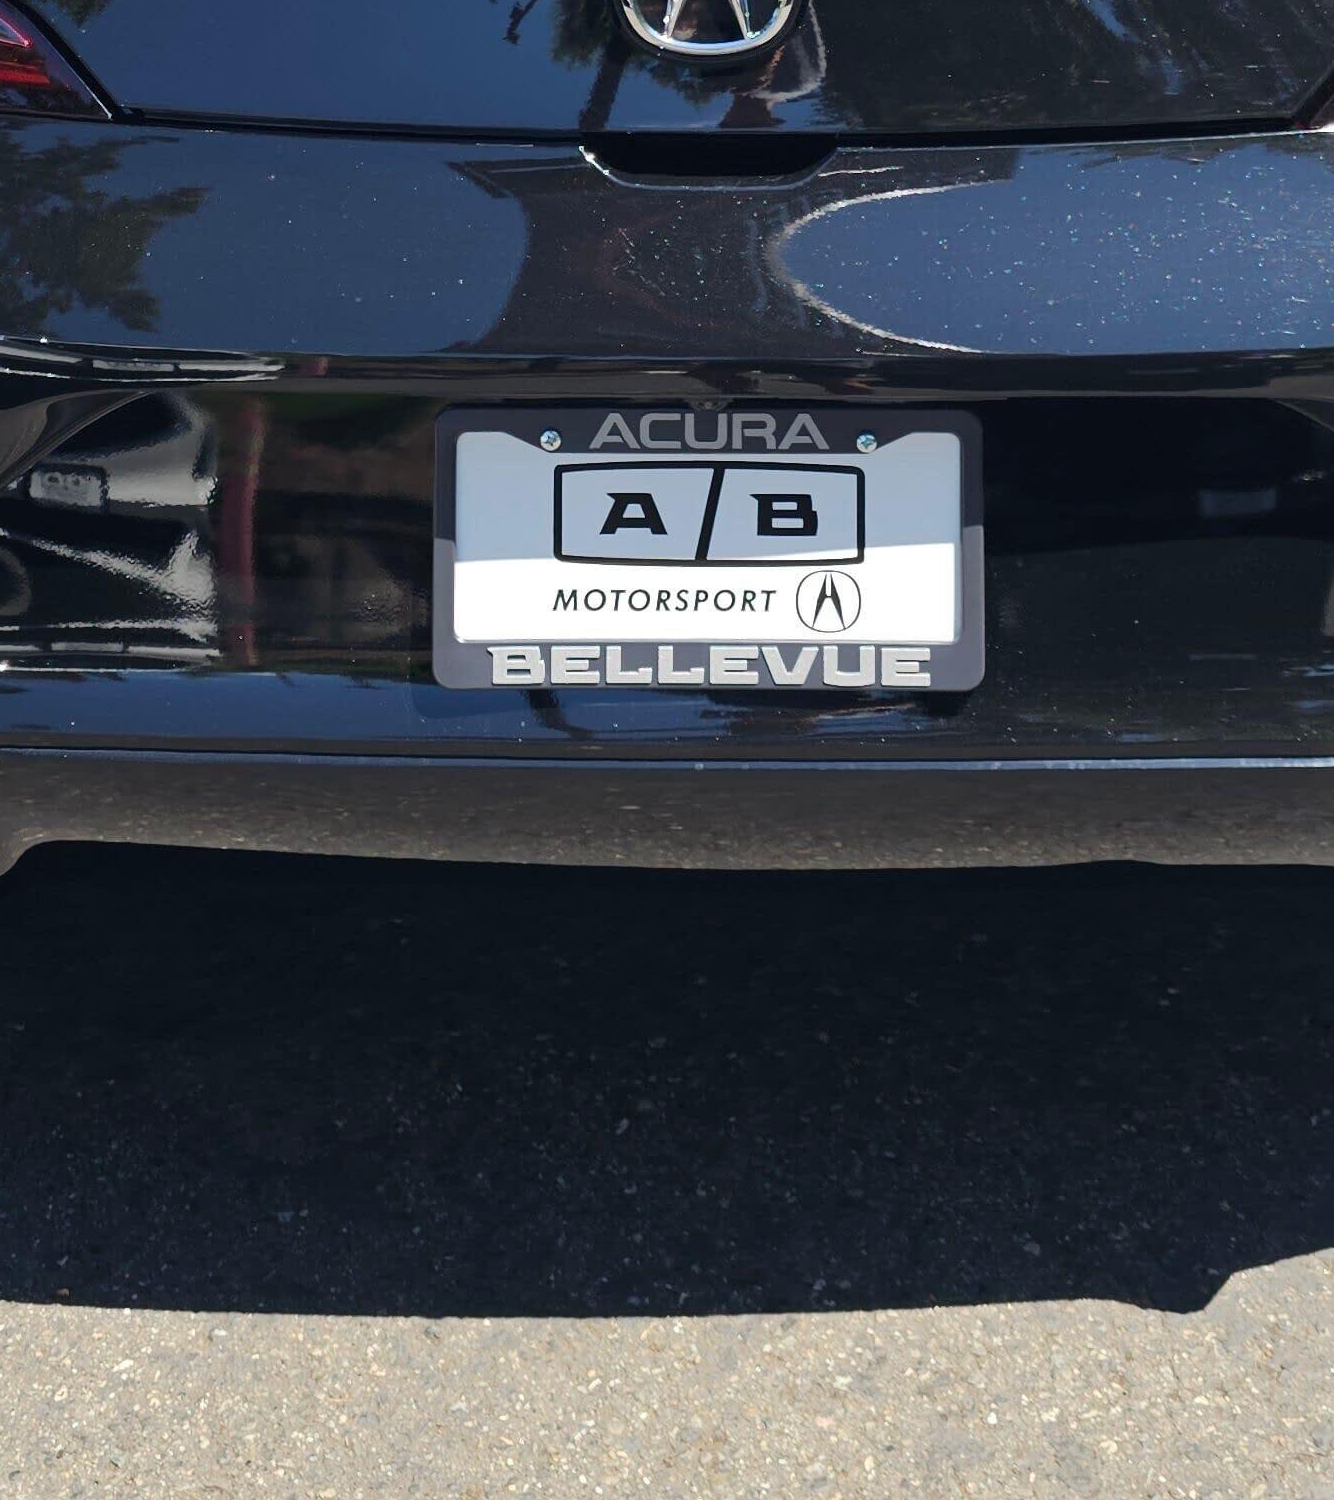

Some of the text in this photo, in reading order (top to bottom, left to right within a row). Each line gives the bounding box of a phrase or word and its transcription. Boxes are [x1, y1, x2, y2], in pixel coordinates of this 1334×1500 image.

[588, 412, 830, 451] ACURA
[599, 492, 819, 537] A B
[551, 588, 778, 613] MOTORSPORT
[486, 644, 932, 688] BELLEVUE
